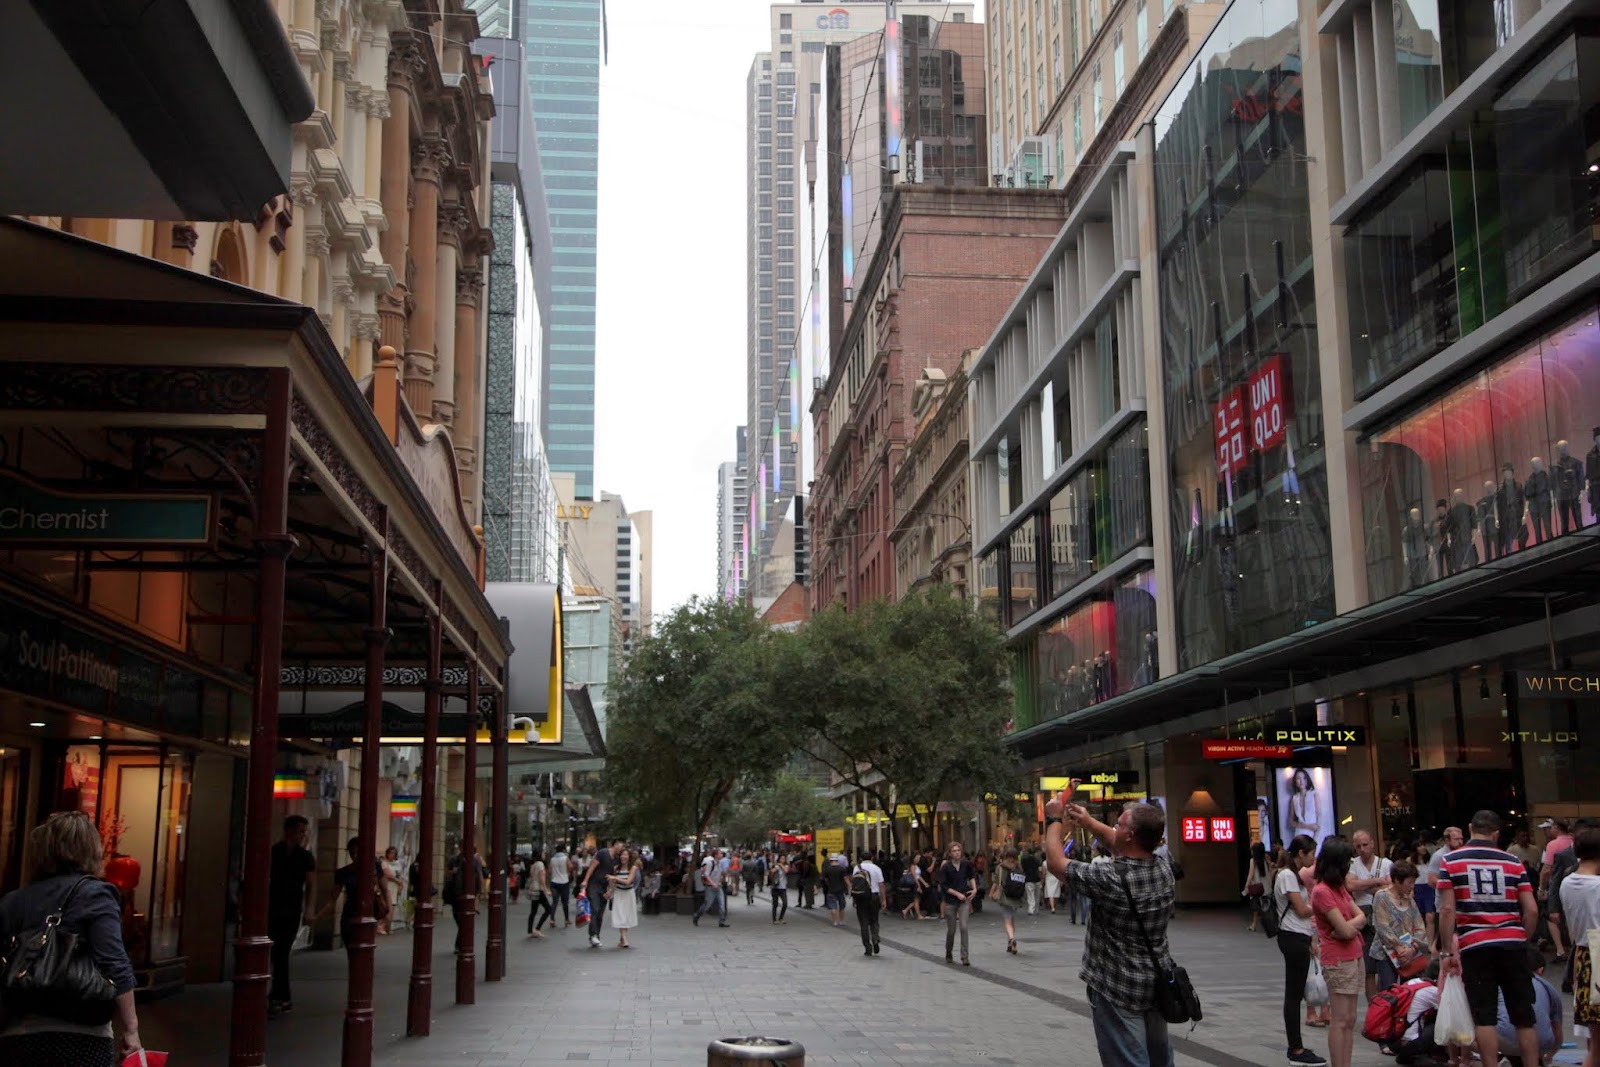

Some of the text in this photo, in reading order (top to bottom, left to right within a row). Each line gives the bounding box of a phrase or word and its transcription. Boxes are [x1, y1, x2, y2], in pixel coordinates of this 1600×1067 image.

[816, 8, 849, 29] citi
[1252, 369, 1276, 411] UNI
[1254, 403, 1281, 448] QLO
[0, 506, 109, 530] Chemist
[18, 629, 56, 673] Soul
[57, 643, 119, 693] Pattinson
[1276, 730, 1356, 742] POLITIX
[1091, 772, 1118, 783] rebel
[1212, 819, 1231, 829] UNI
[1213, 829, 1233, 841] QLO
[1471, 867, 1503, 896] H
